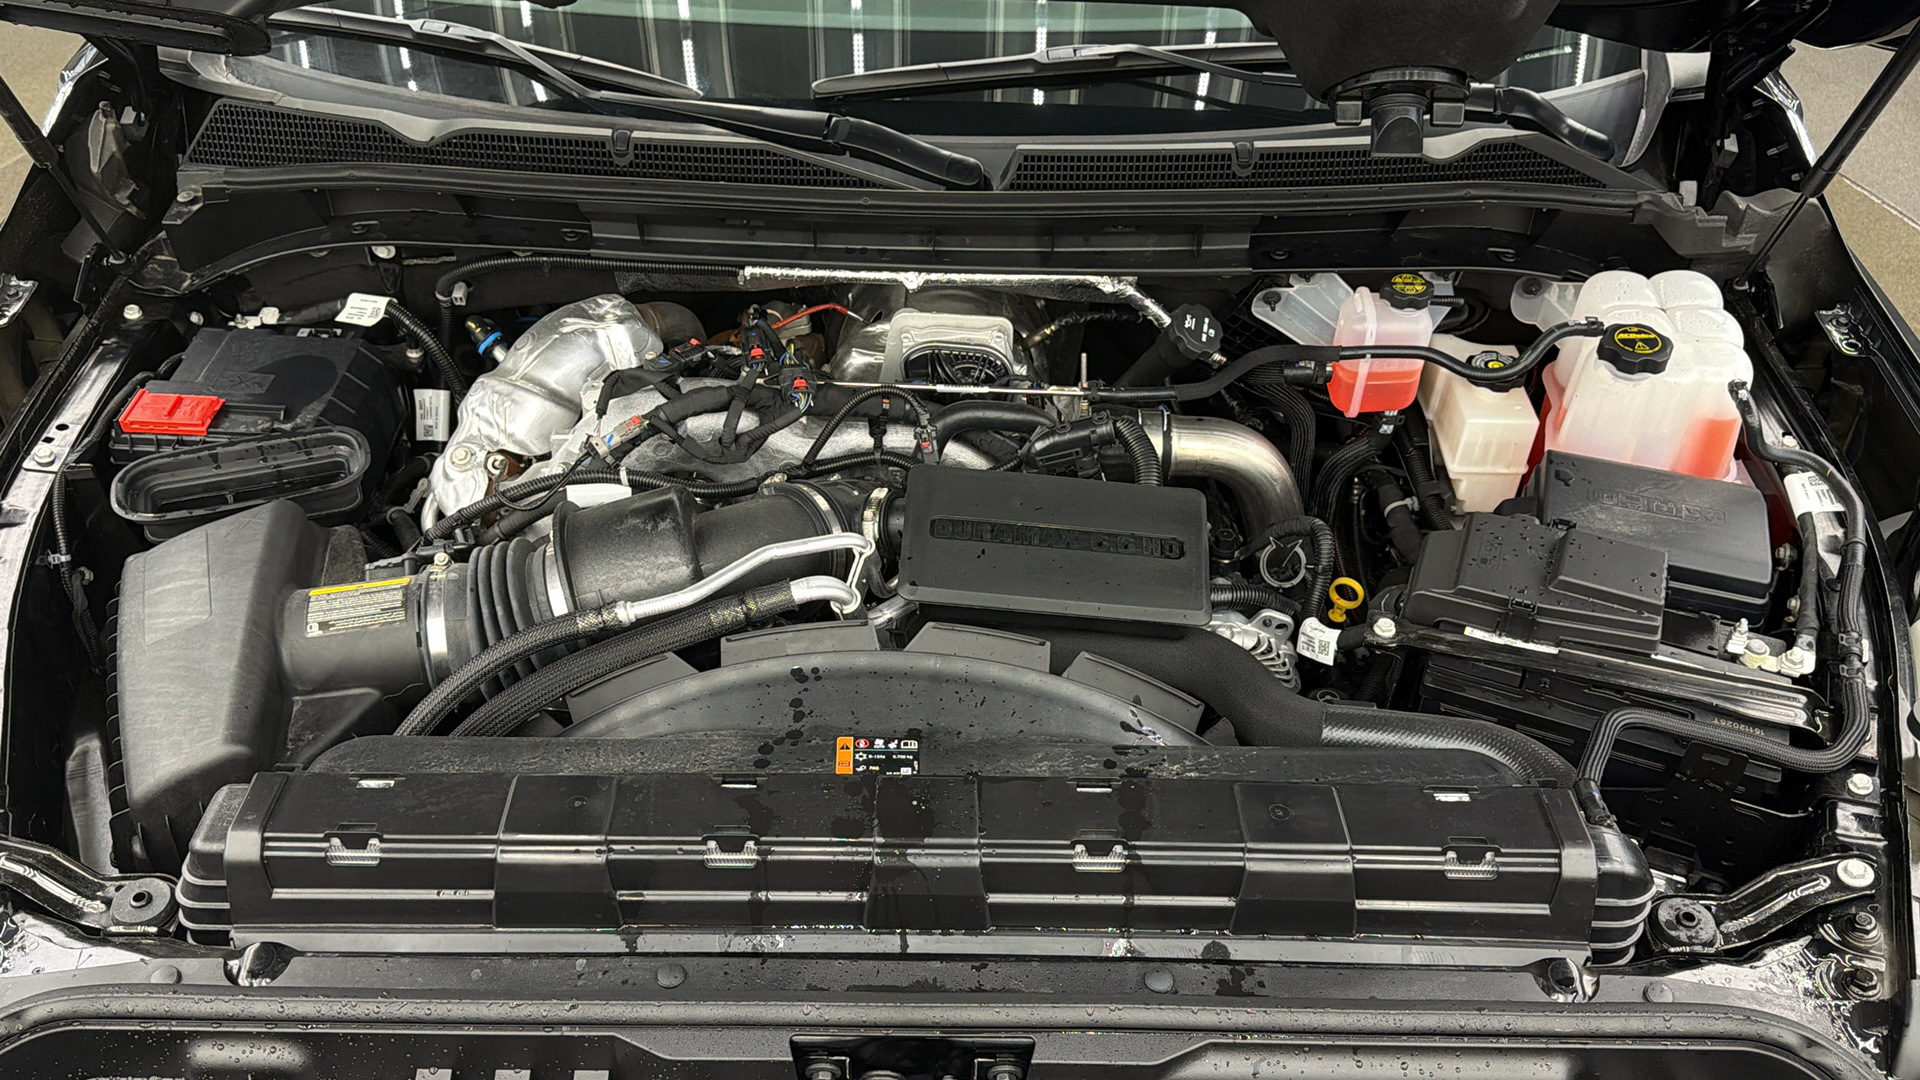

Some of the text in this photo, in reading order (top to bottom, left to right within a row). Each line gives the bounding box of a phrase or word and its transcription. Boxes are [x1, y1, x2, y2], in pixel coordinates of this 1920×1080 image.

[934, 519, 1185, 560] DURAMAX 6.6 HD
